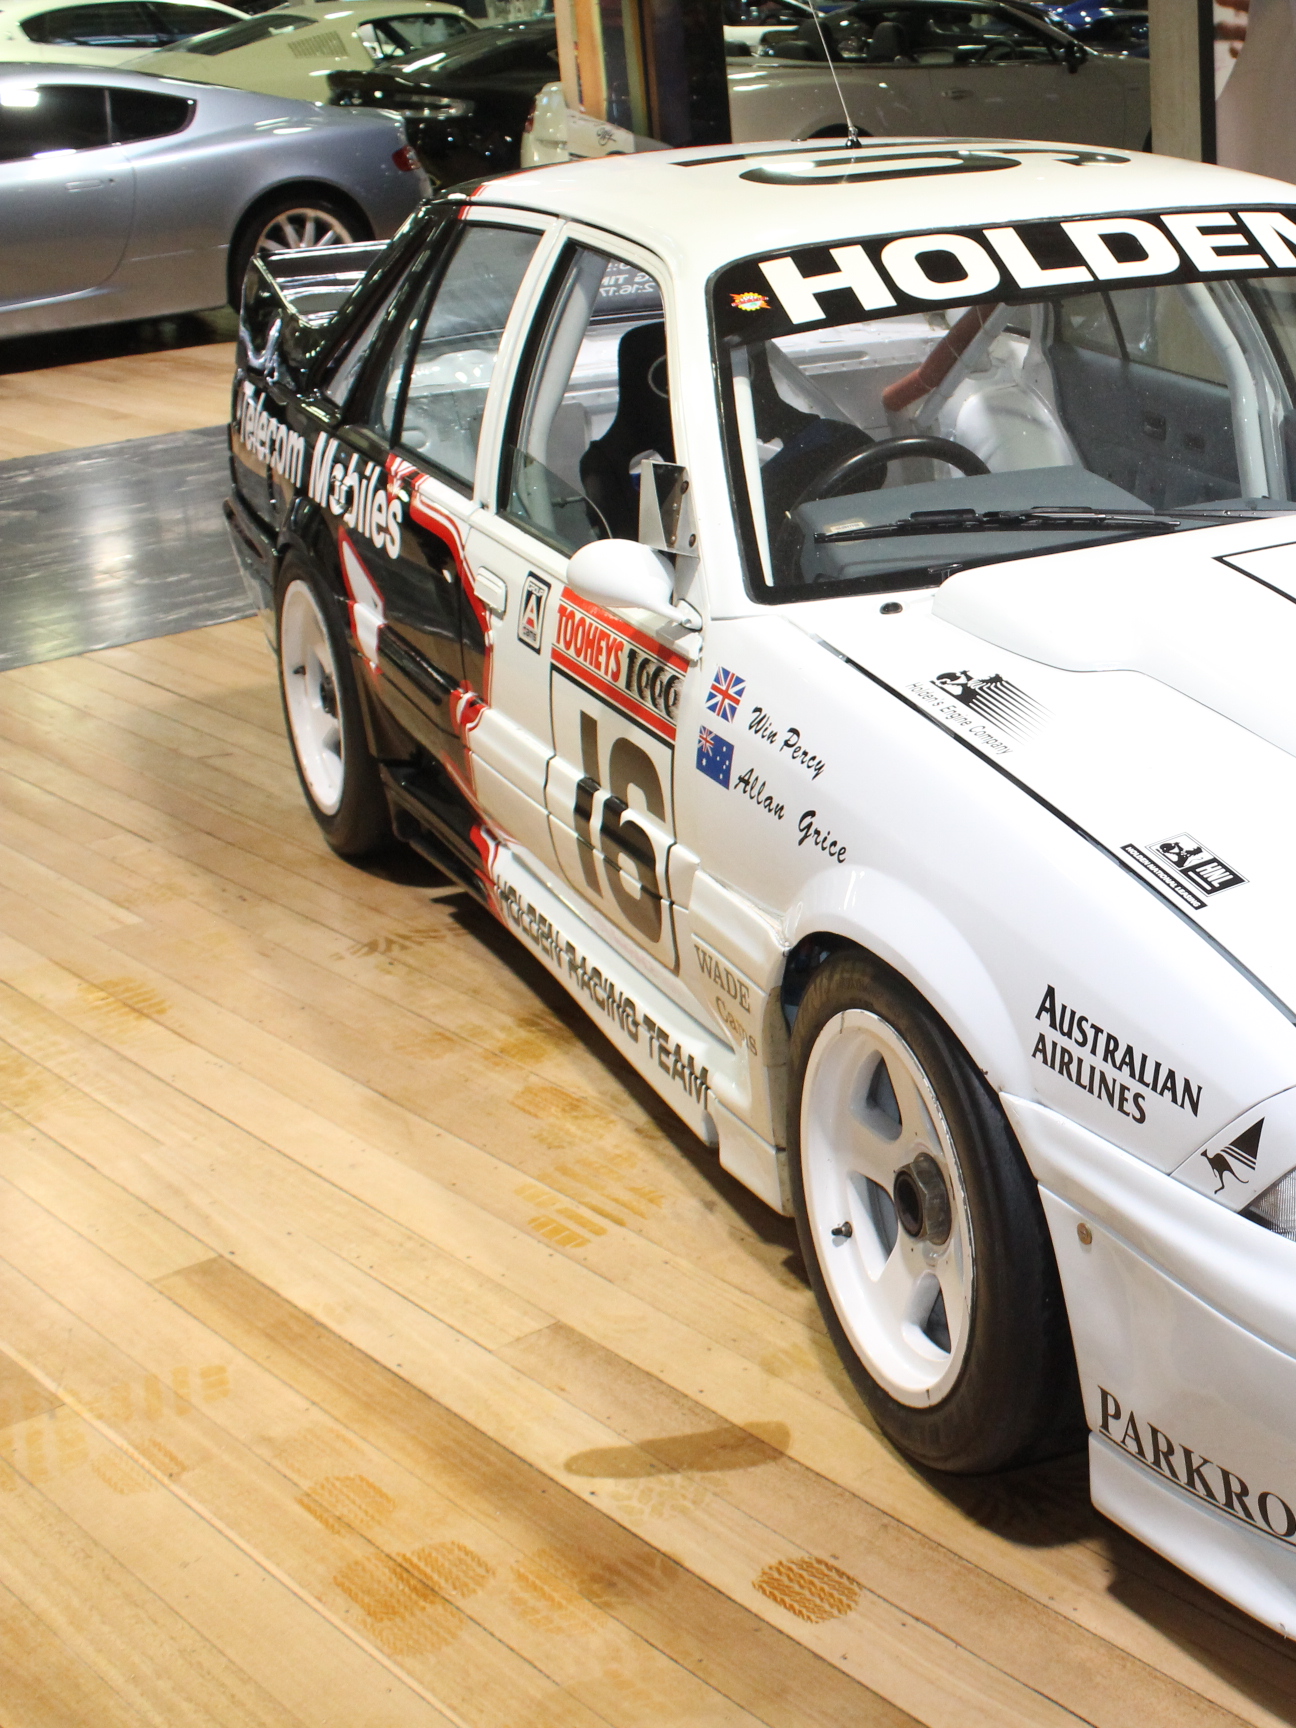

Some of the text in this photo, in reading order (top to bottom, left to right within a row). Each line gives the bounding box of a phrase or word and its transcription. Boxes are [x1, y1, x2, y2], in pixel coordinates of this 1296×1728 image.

[238, 380, 403, 560] Telecom Mobiles
[556, 602, 625, 683] TOOHEYS
[748, 706, 826, 781] Win Percy
[905, 682, 1013, 755] Holden's Engine Company
[573, 709, 667, 944] 16
[734, 767, 847, 864] Allan Grice
[1196, 861, 1234, 888] HNL
[495, 873, 710, 1111] HOLDEN RACING TEAM
[694, 944, 751, 1014] WADE
[1031, 1031, 1147, 1125] AIRLINES
[1035, 983, 1203, 1118] AUSTRALIAN
